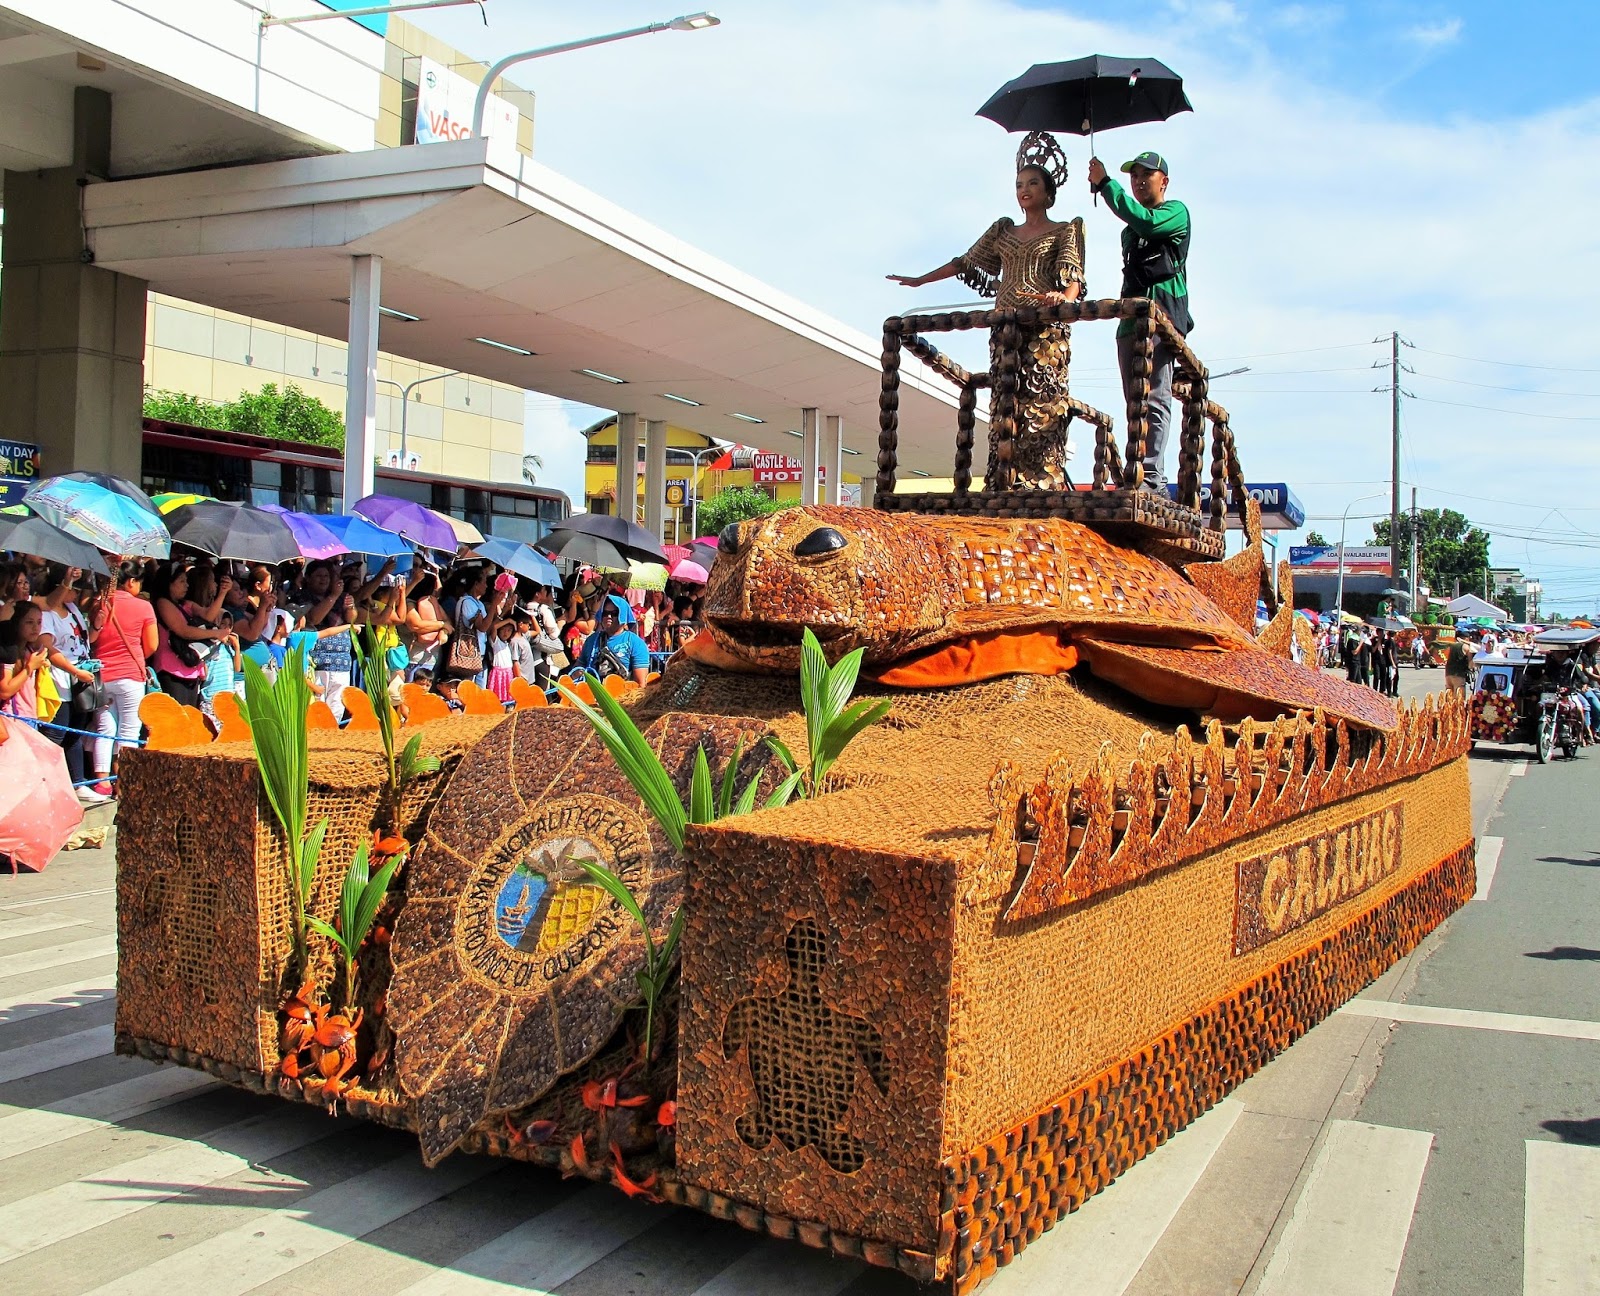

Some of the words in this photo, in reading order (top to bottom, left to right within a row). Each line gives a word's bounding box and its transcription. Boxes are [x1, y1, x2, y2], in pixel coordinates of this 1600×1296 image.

[14, 447, 34, 459] DAY
[755, 455, 784, 469] CASTLE
[760, 471, 826, 481] HOTL
[671, 489, 680, 500] B
[1199, 487, 1279, 505] PTON
[469, 804, 592, 902] MUNICIPALITY
[585, 808, 614, 835] OF
[1261, 810, 1397, 931] CALAUAG
[465, 907, 518, 984] PROVINCE
[513, 962, 541, 986] OF
[544, 916, 619, 980] QUEZON
